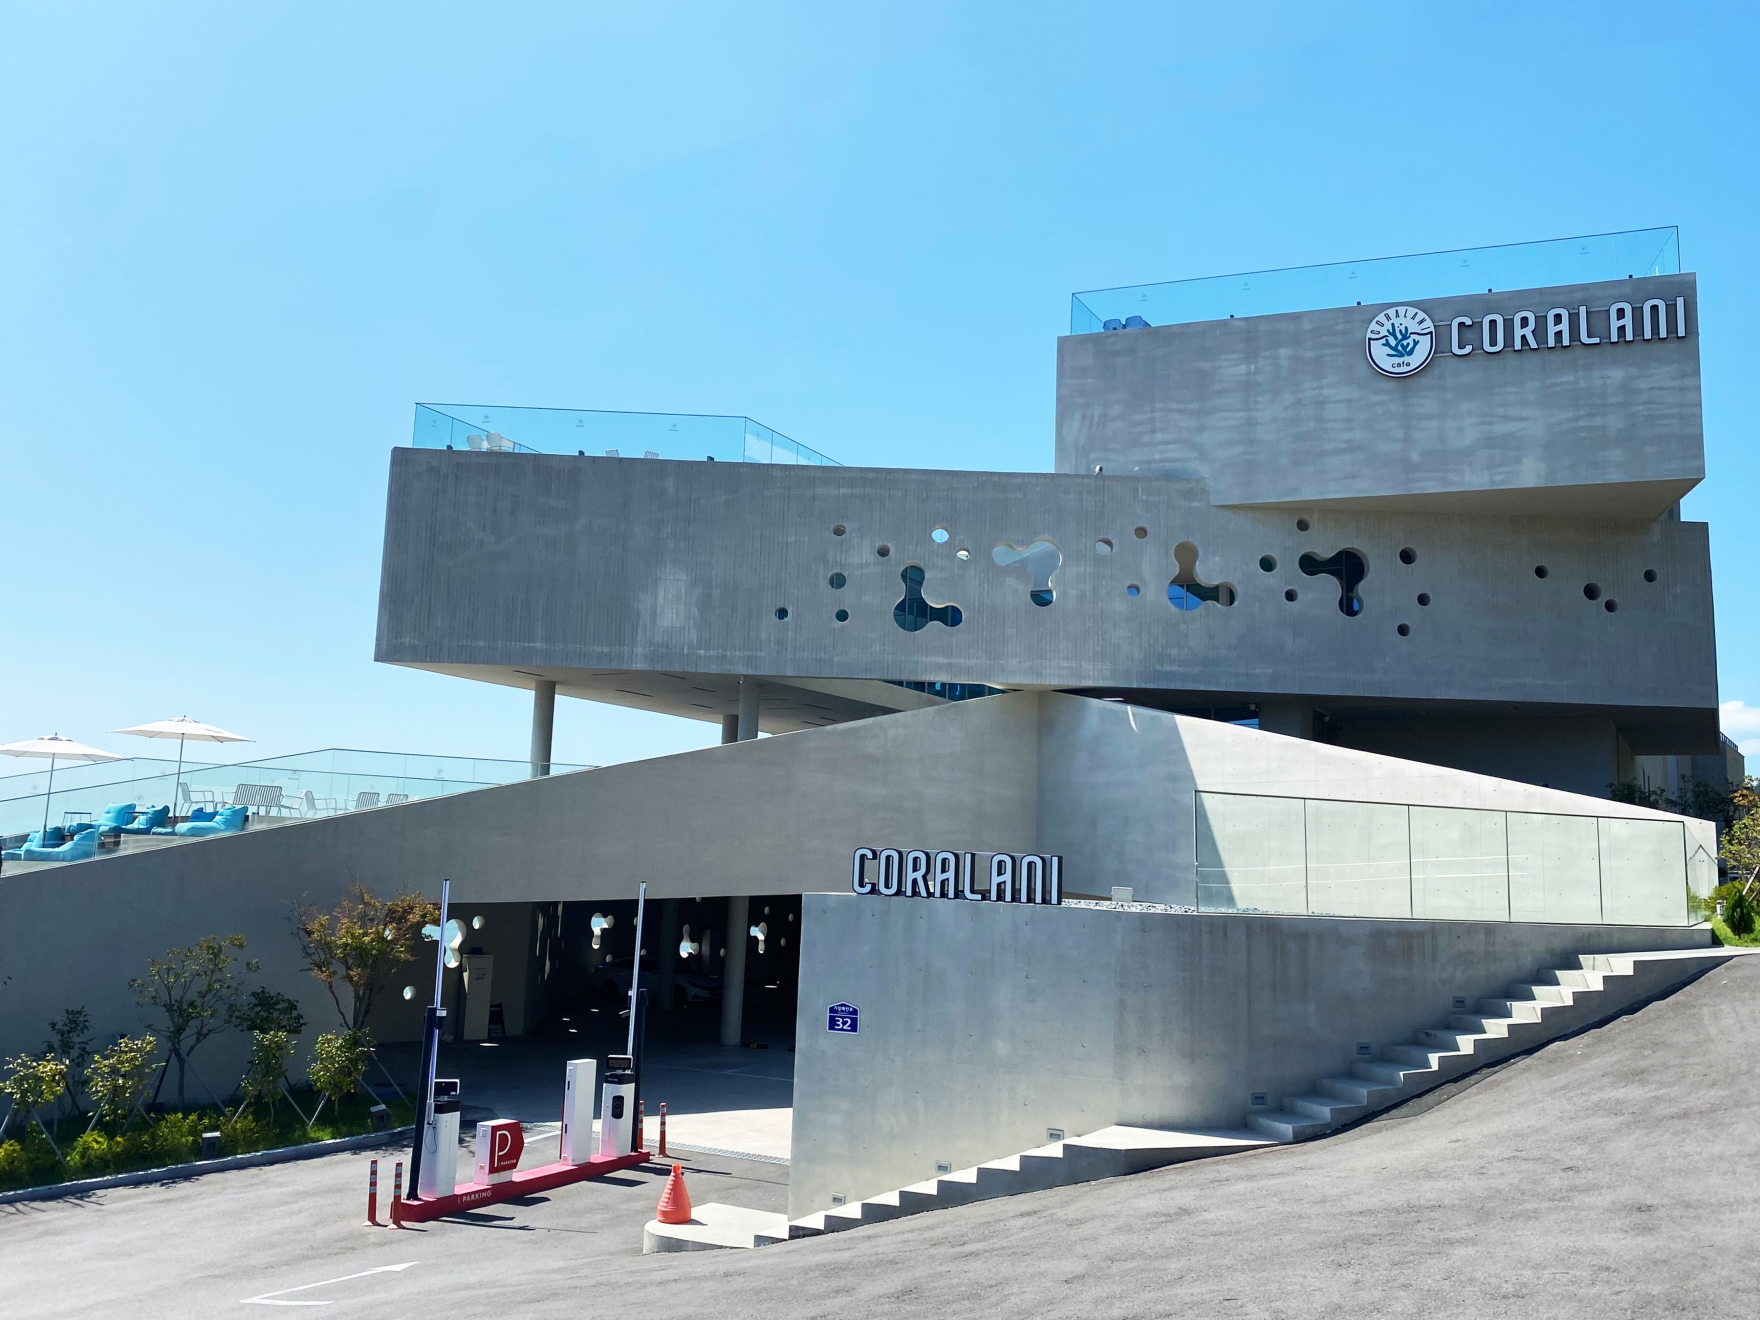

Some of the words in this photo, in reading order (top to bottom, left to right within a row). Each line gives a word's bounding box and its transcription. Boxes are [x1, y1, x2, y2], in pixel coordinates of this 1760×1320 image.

[1370, 308, 1431, 335] CORALANI
[1450, 296, 1687, 356] CORALANI
[1391, 360, 1411, 368] cafe
[852, 847, 1063, 905] CORALANI
[834, 1017, 852, 1030] 32
[494, 1130, 511, 1168] P
[462, 1190, 492, 1203] PARKING
